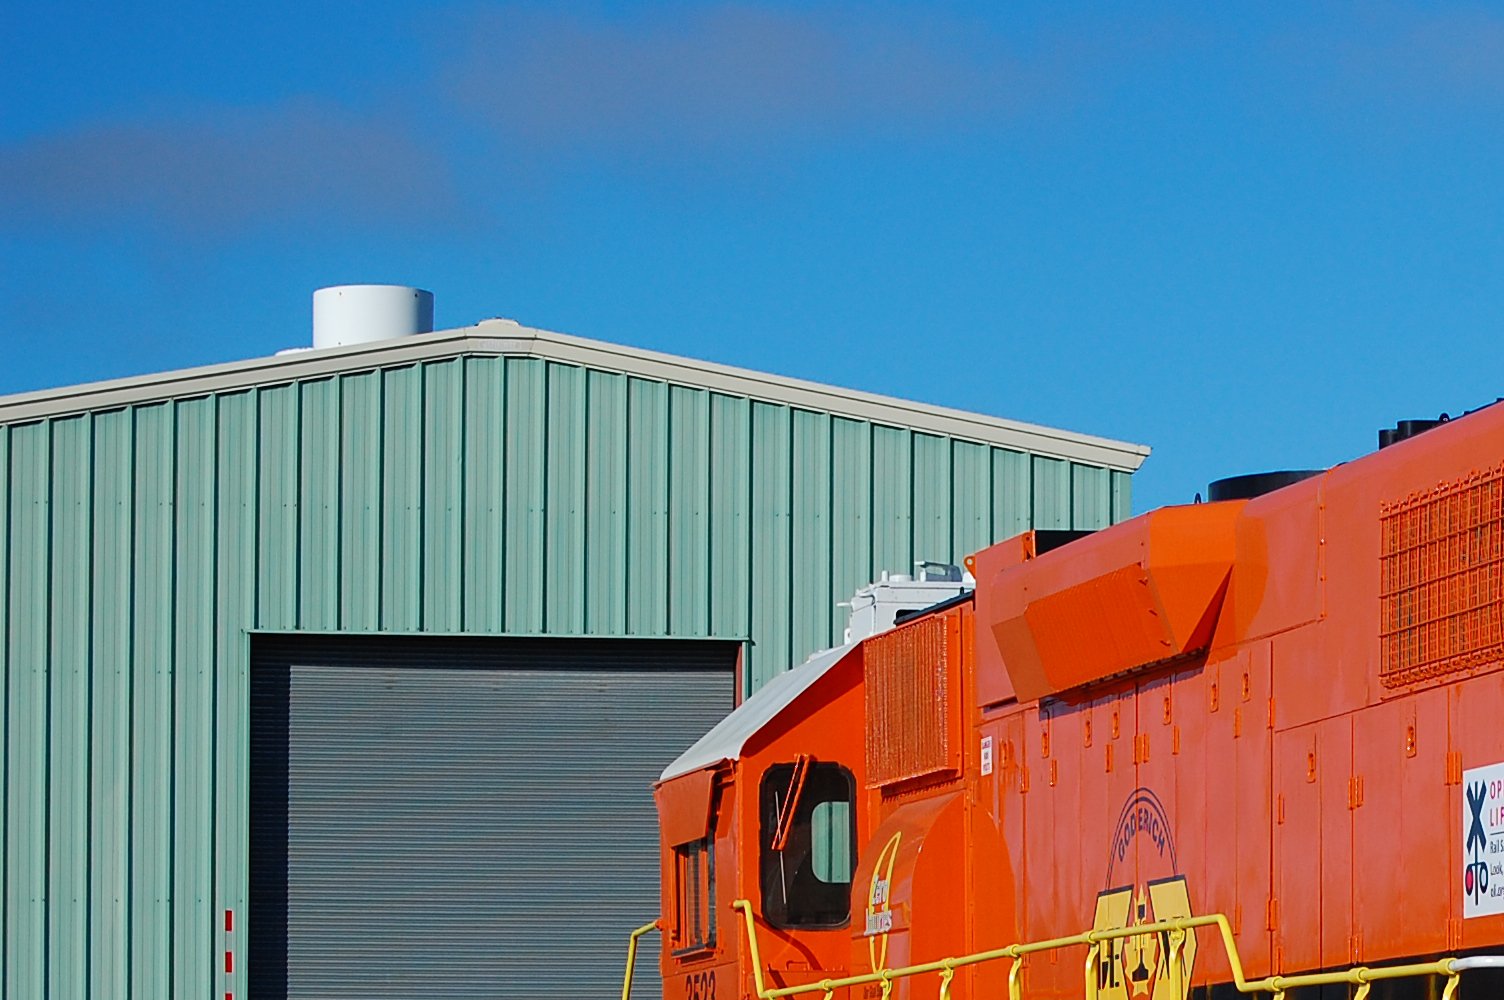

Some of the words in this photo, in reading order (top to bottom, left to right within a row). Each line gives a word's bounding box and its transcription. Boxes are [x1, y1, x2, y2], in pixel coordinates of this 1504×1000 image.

[1118, 807, 1165, 862] GODERICH
[1490, 840, 1500, 854] Rail
[1490, 861, 1503, 876] Look,
